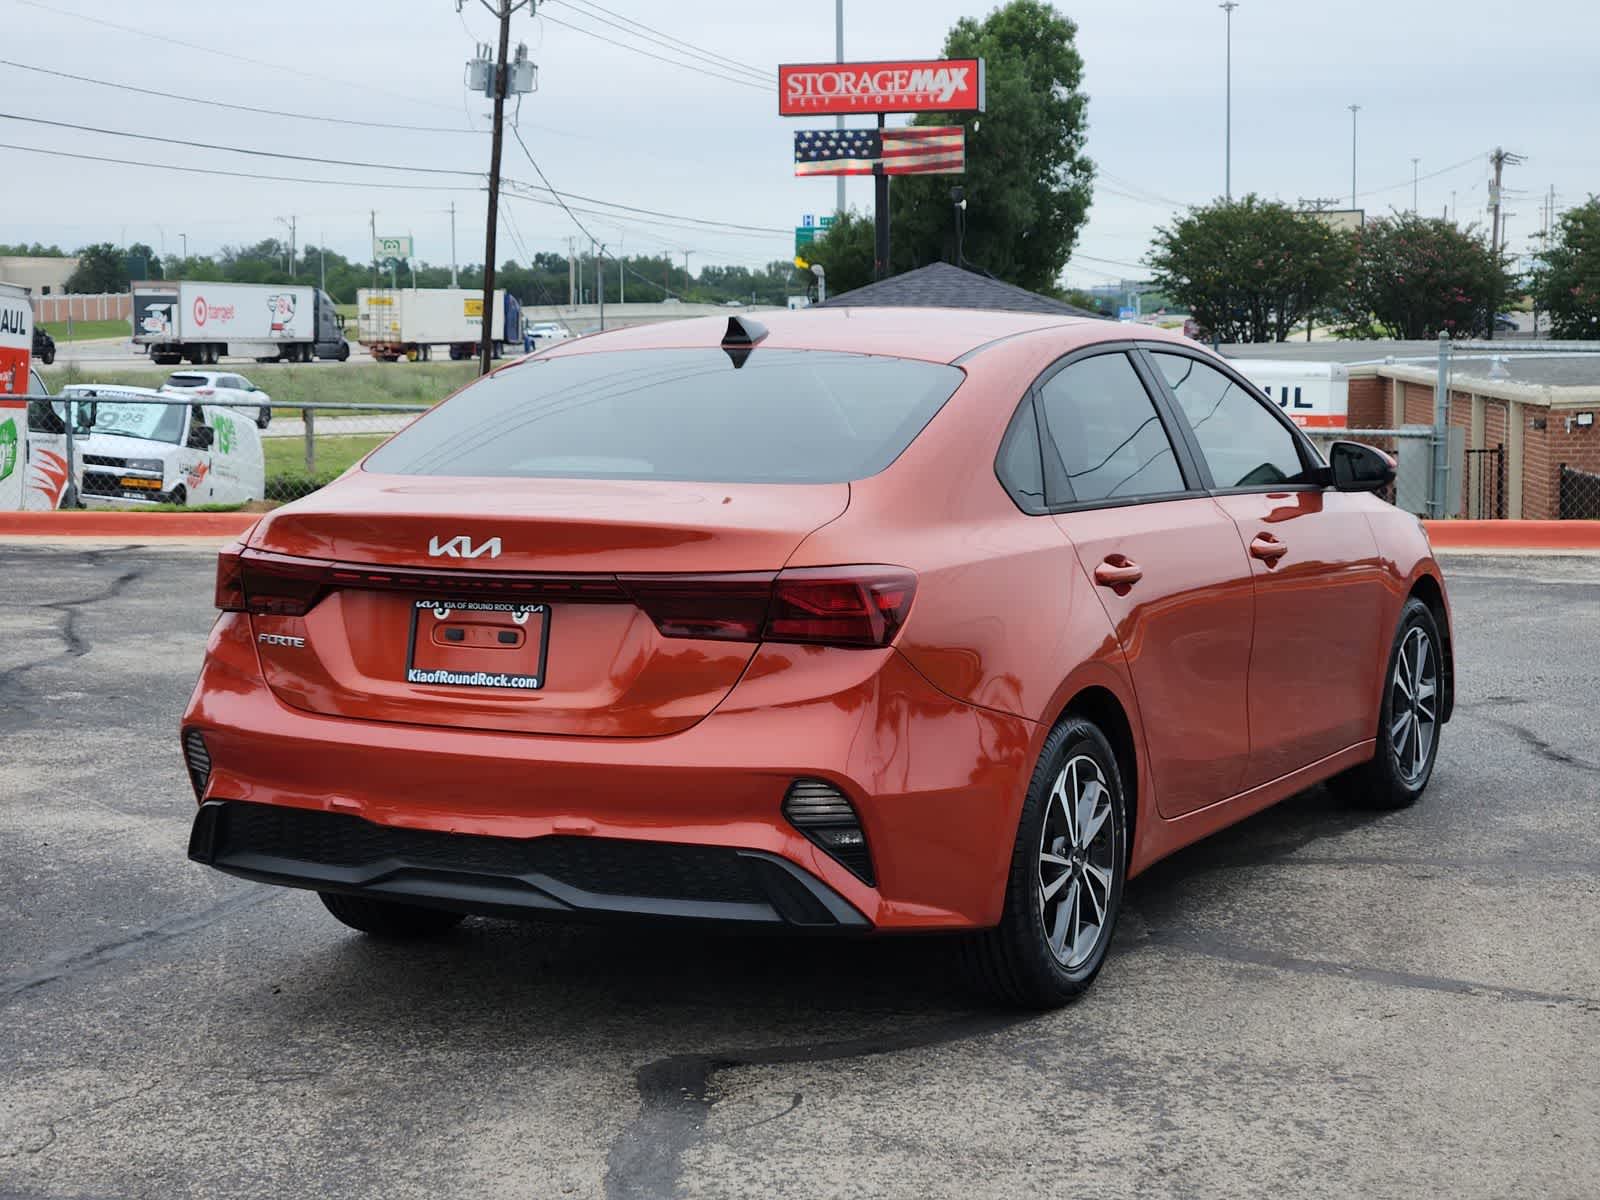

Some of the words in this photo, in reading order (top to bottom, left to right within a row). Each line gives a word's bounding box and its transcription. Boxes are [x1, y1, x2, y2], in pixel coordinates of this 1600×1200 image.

[429, 535, 502, 559] KIA
[468, 602, 493, 610] ROUND
[494, 603, 514, 611] ROCK
[408, 668, 538, 689] KiaofRoundRock.com
